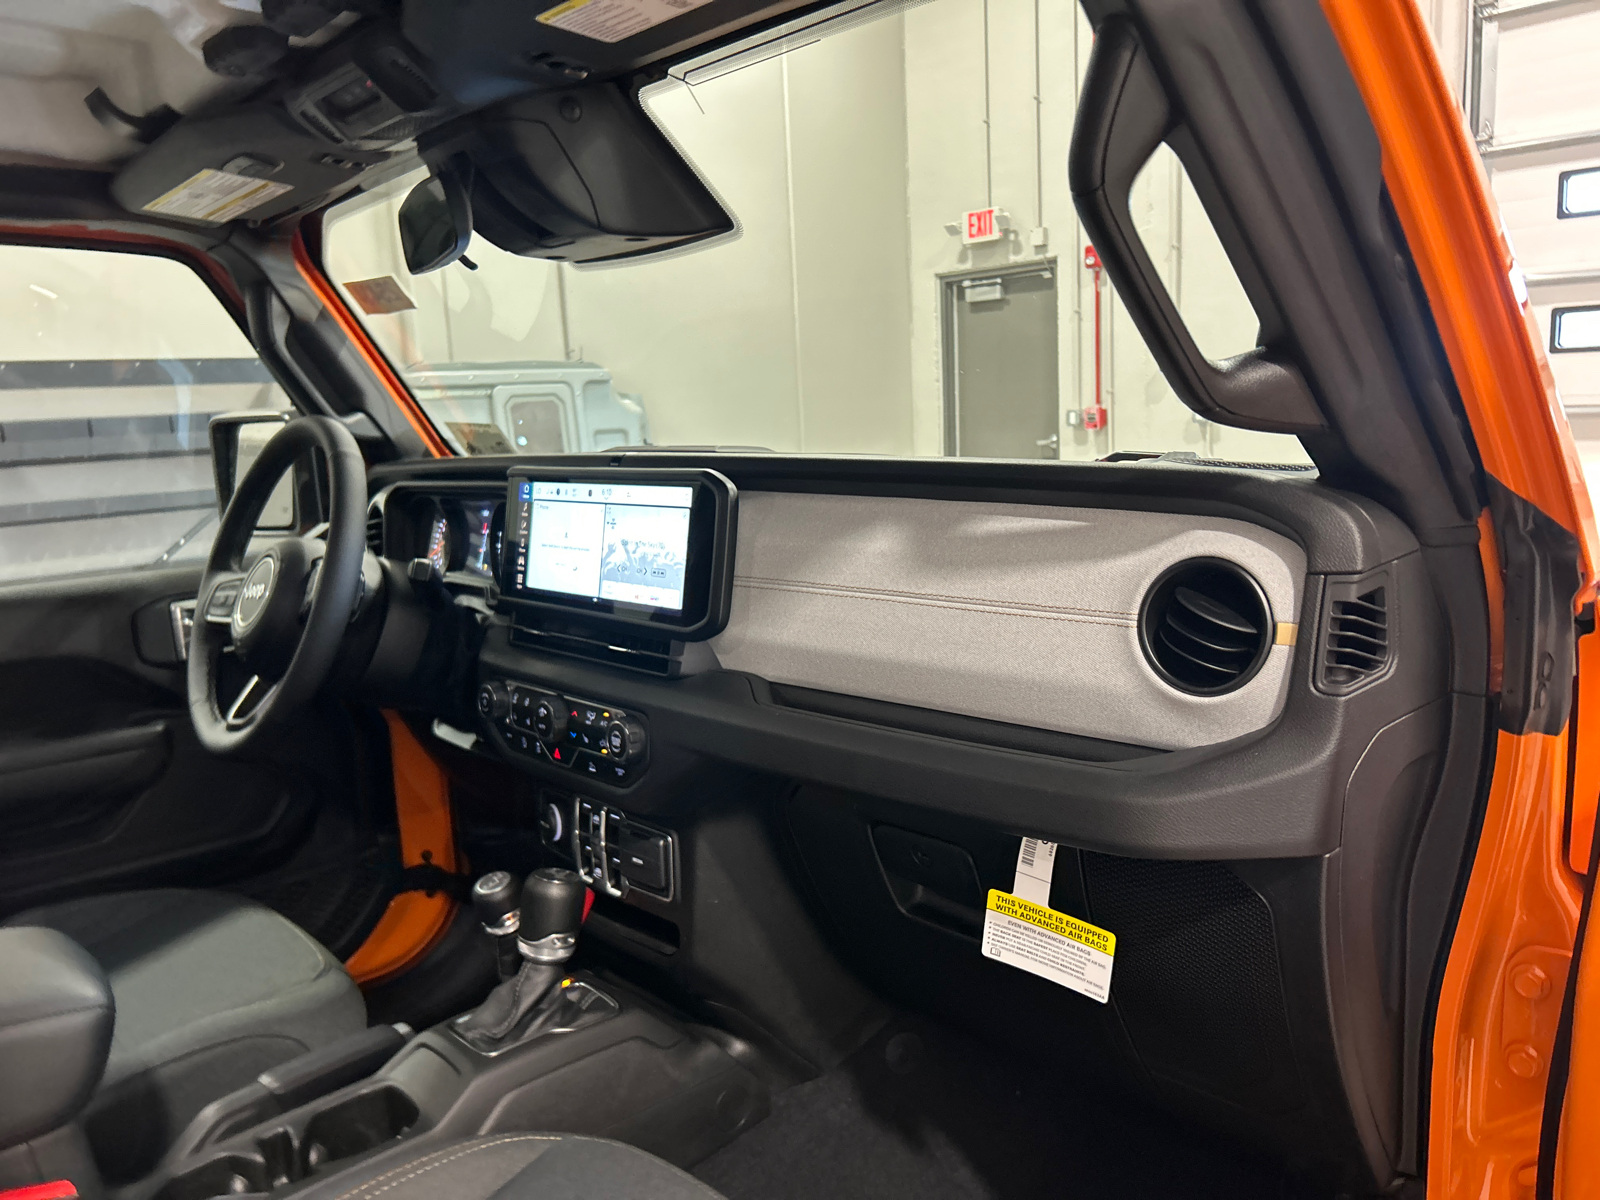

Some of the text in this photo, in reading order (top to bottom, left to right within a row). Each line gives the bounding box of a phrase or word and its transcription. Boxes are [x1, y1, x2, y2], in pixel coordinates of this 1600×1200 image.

[968, 210, 994, 238] EXIT
[995, 902, 1107, 951] WITH ADVANCED AIR BAGS
[996, 894, 1108, 942] THIS VEHICLE IS EQUIPPED
[1007, 919, 1021, 929] EVEN
[1022, 924, 1036, 934] WITH
[1036, 930, 1065, 945] ADVANCED
[1076, 945, 1090, 956] BAGS
